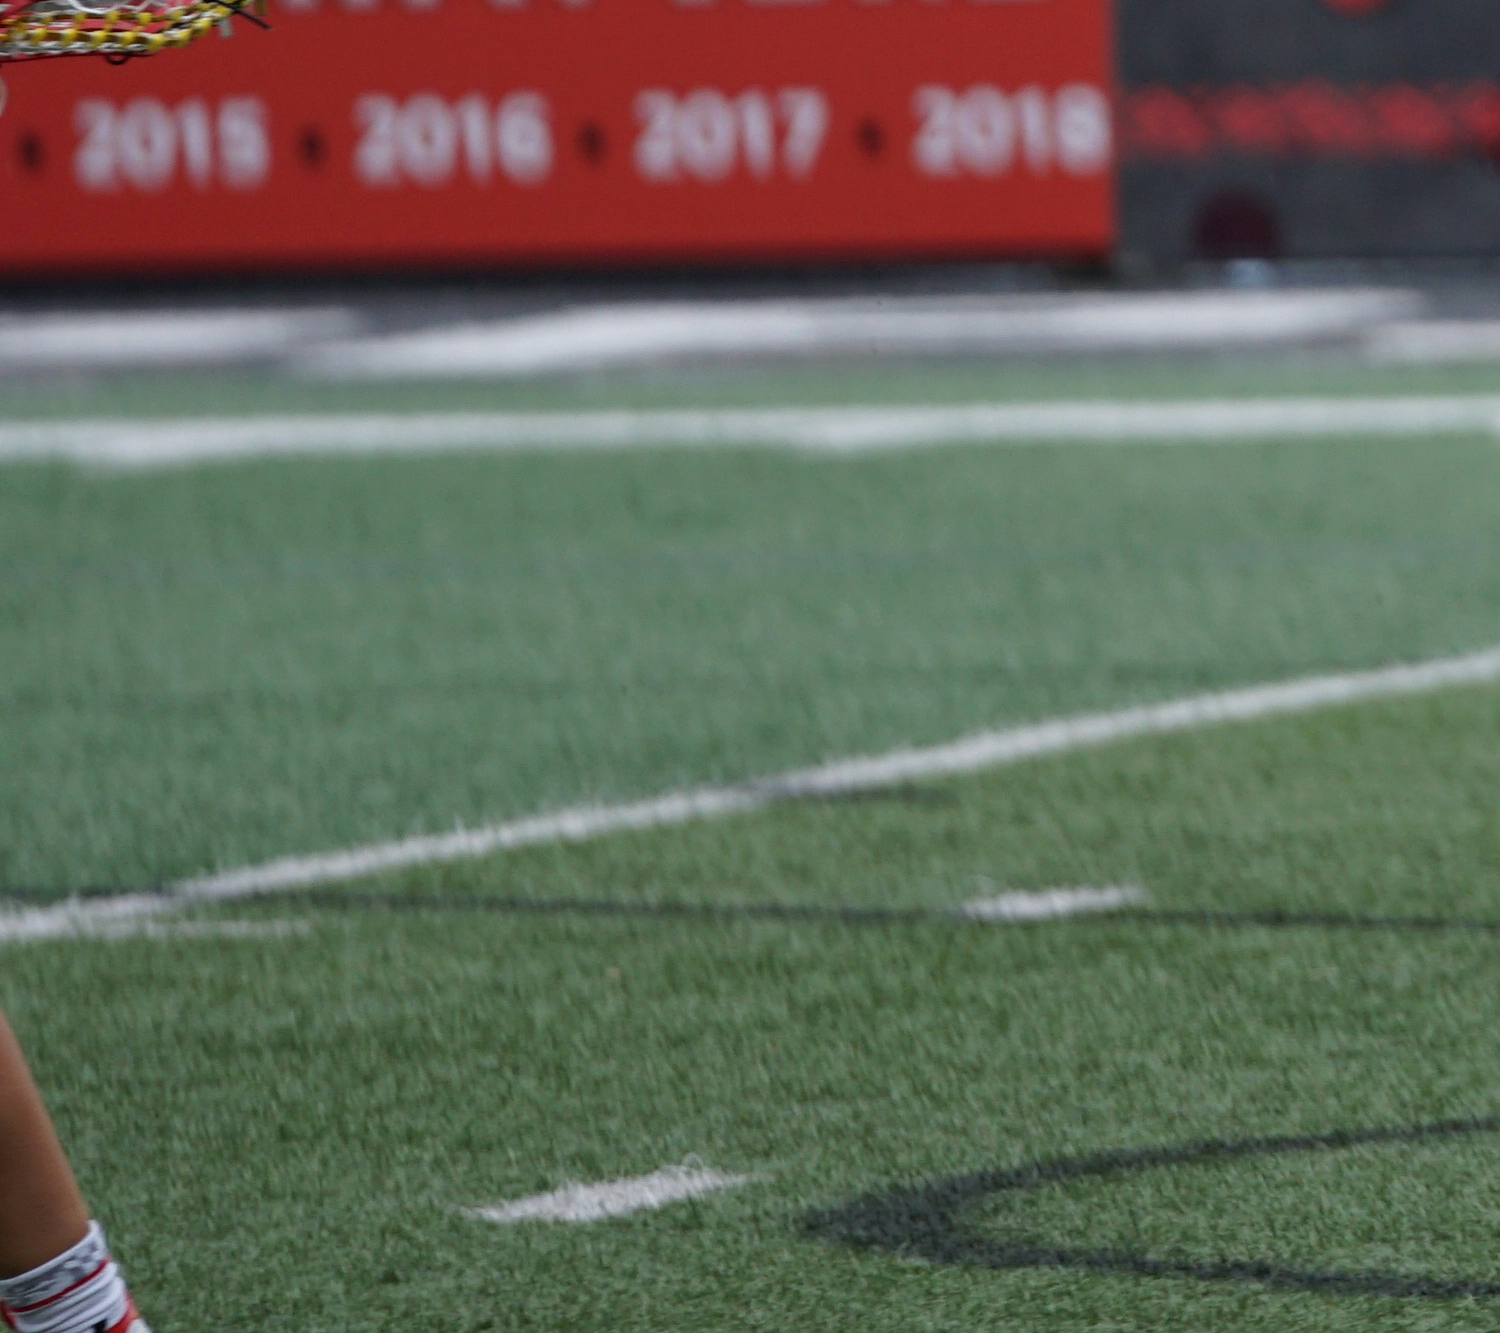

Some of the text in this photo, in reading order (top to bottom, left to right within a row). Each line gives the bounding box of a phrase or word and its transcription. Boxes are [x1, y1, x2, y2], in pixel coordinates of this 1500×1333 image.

[73, 95, 272, 192] 2015
[352, 90, 555, 187] 2016
[632, 85, 828, 183] 2017
[911, 81, 1113, 179] 2018
